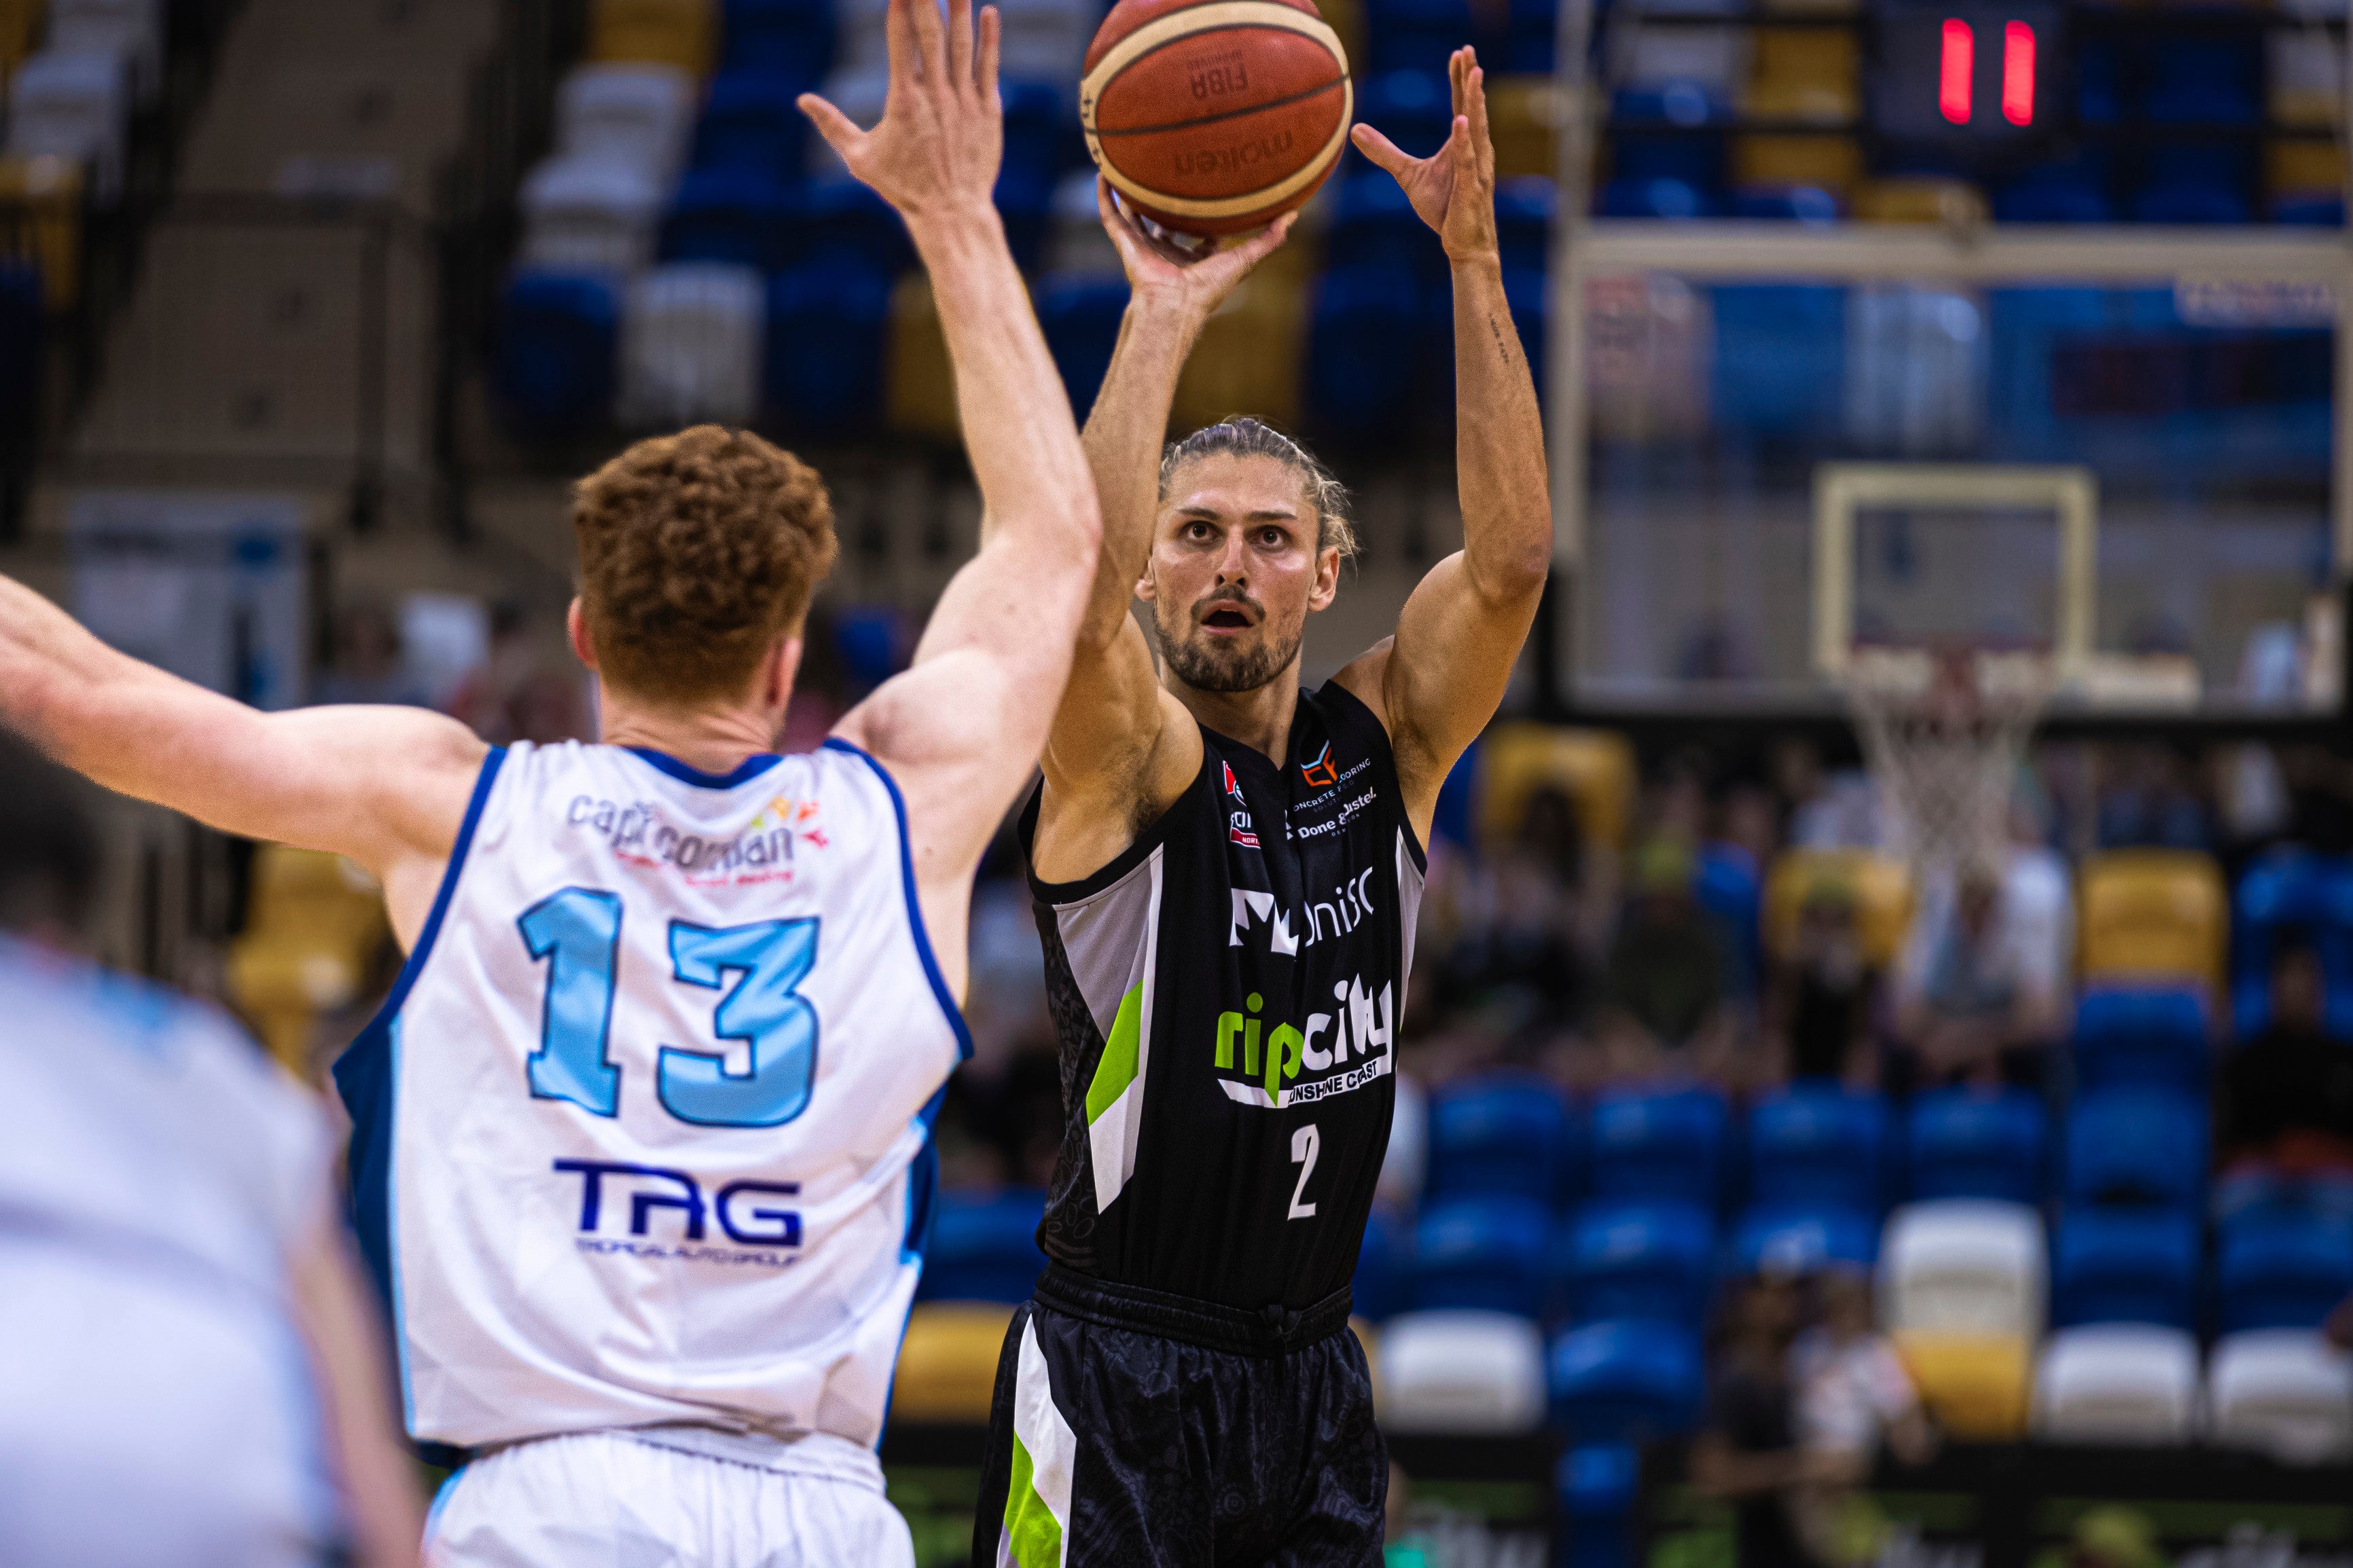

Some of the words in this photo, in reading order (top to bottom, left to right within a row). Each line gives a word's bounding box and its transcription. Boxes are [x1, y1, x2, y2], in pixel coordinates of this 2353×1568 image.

[1188, 58, 1249, 100] FIBA
[1939, 18, 2036, 127] 11
[1173, 131, 1294, 177] molten
[1293, 789, 1336, 813] ONCRETE
[1337, 757, 1371, 792] FOORING
[1242, 837, 1260, 845] NORT
[1297, 819, 1337, 840] Done
[516, 886, 821, 1129] 13
[1289, 1076, 1343, 1104] UNSHNE
[1287, 1123, 1321, 1221] 2
[552, 1158, 804, 1247] TAG
